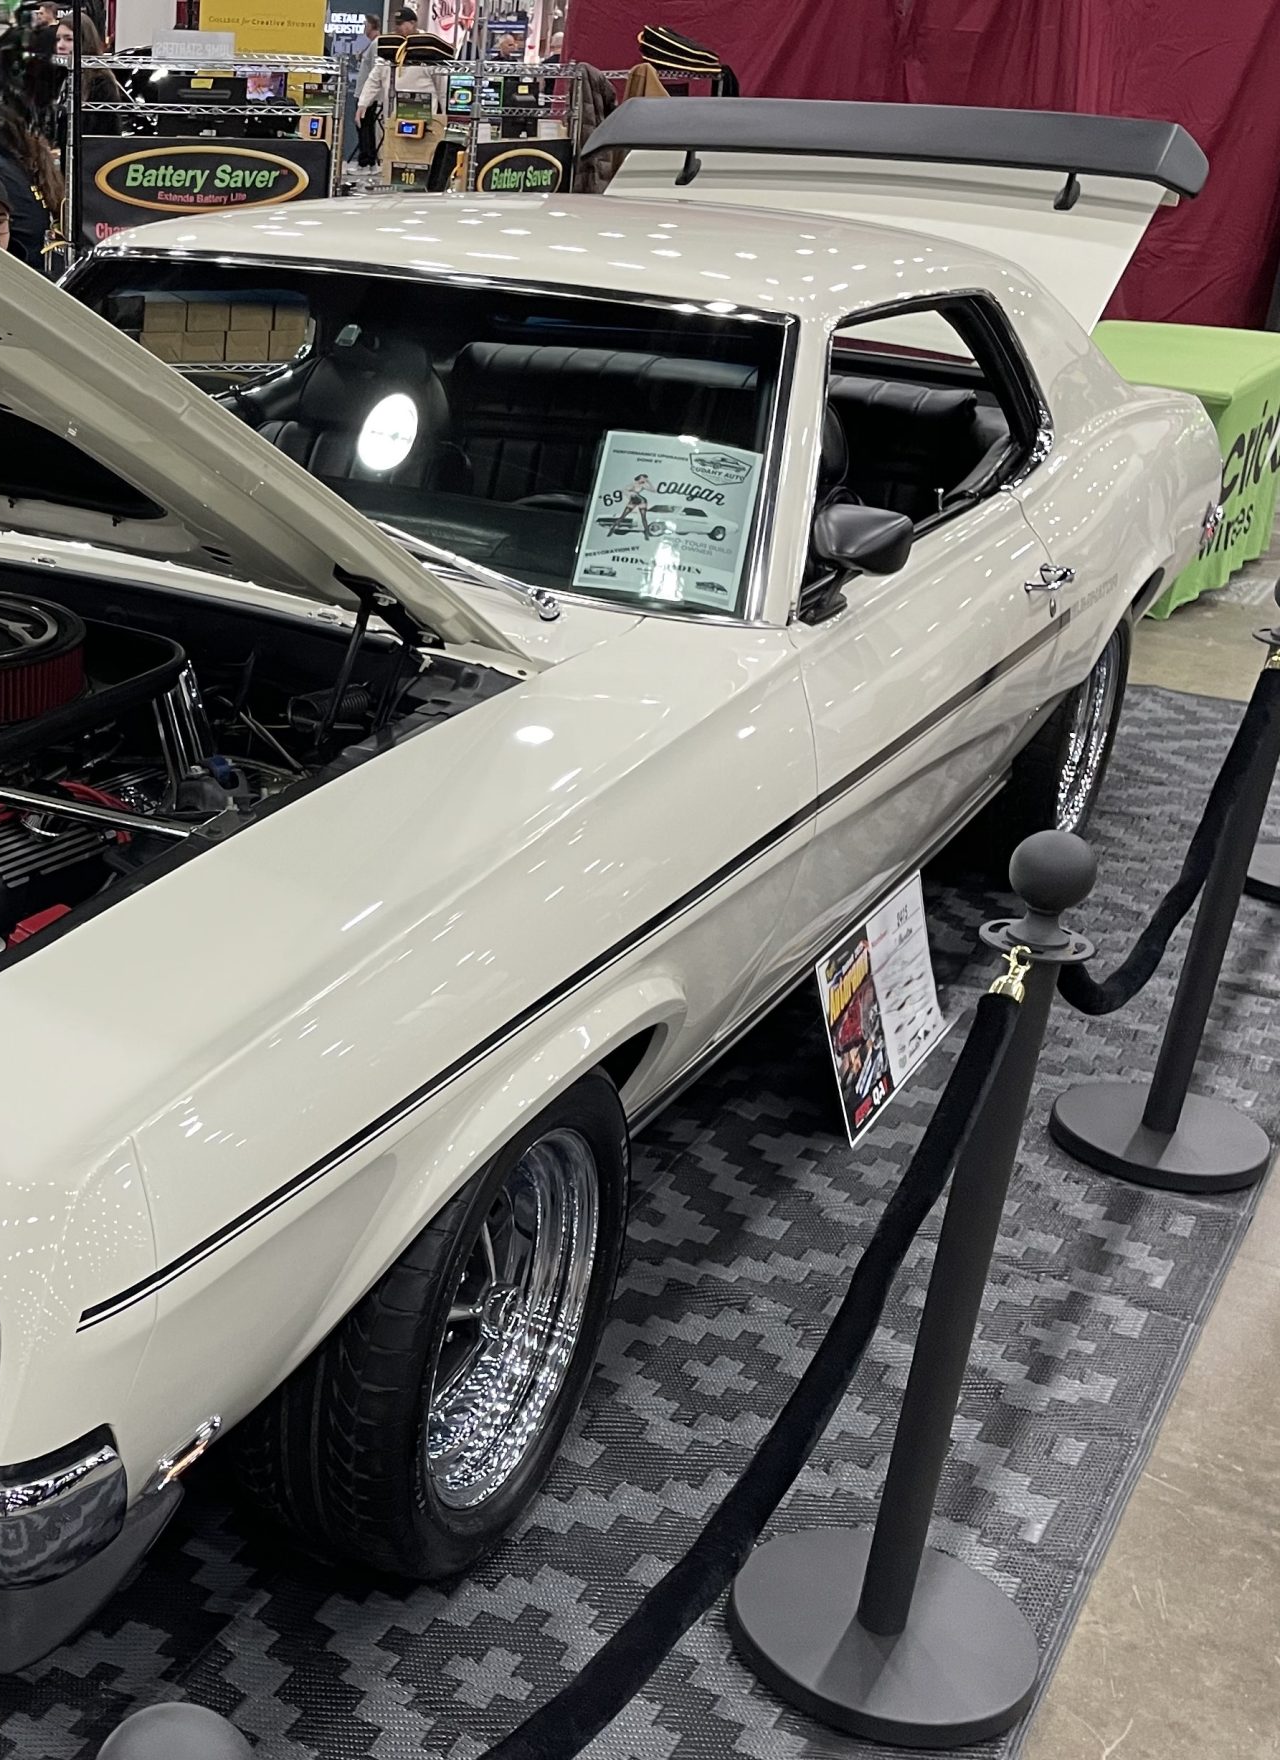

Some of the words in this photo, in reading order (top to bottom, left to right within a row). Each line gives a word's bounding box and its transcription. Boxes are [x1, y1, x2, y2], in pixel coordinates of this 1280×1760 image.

[251, 18, 285, 27] Creative
[125, 164, 210, 193] Battery
[214, 164, 279, 189] Saver
[401, 172, 415, 185] $10
[490, 167, 526, 193] Battery
[525, 165, 554, 188] Saver
[157, 190, 195, 204] Extends
[196, 193, 229, 205] Battery
